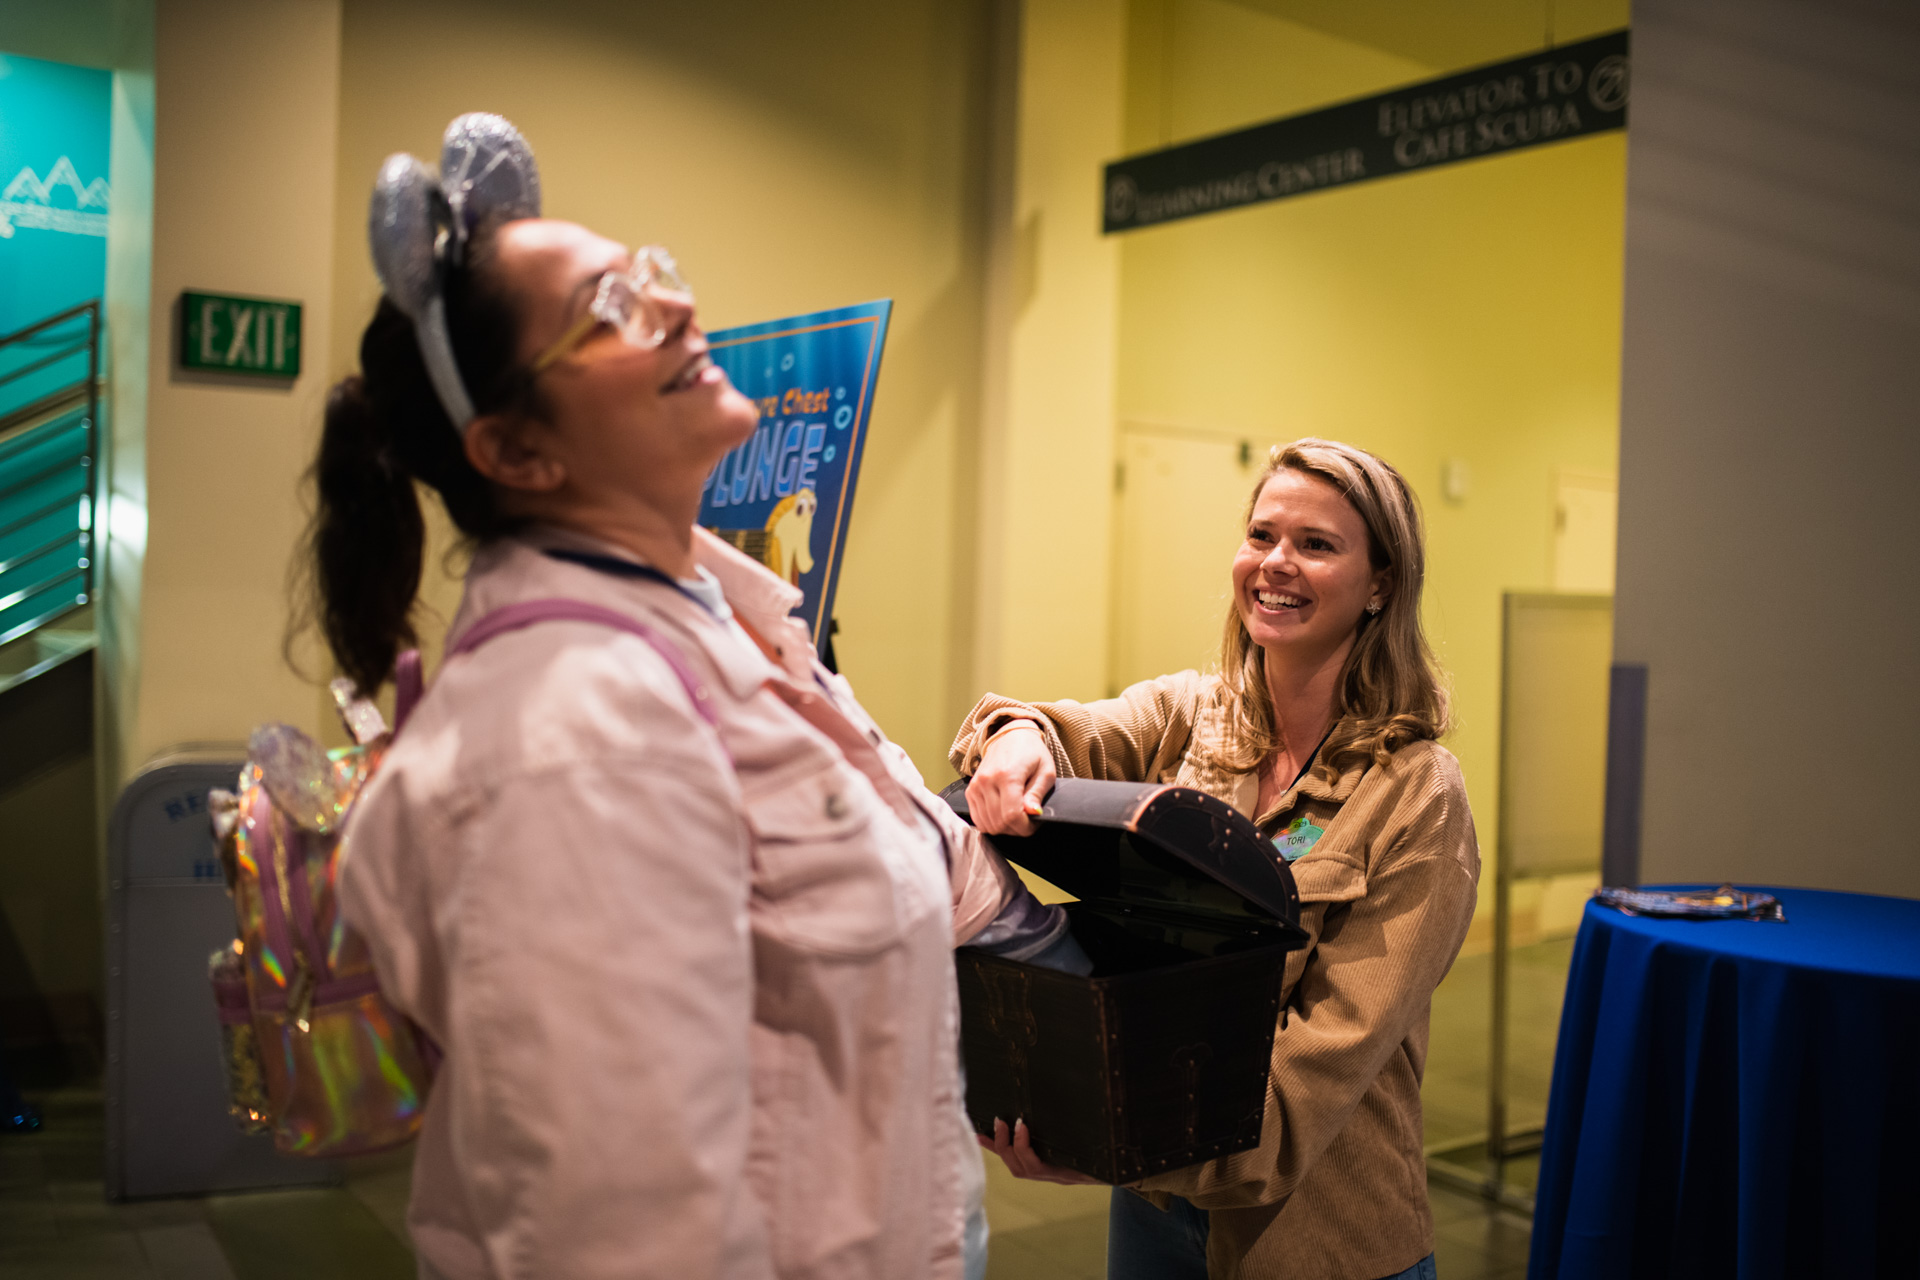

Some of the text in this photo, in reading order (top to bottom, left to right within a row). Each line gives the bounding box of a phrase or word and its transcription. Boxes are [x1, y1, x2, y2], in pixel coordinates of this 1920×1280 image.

[1378, 61, 1583, 136] ELEVATOR TO
[1475, 102, 1581, 151] SCUBA
[1257, 147, 1365, 197] CENTER
[200, 299, 290, 369] EXIT
[782, 388, 831, 415] Chest
[1287, 836, 1306, 846] TORI
